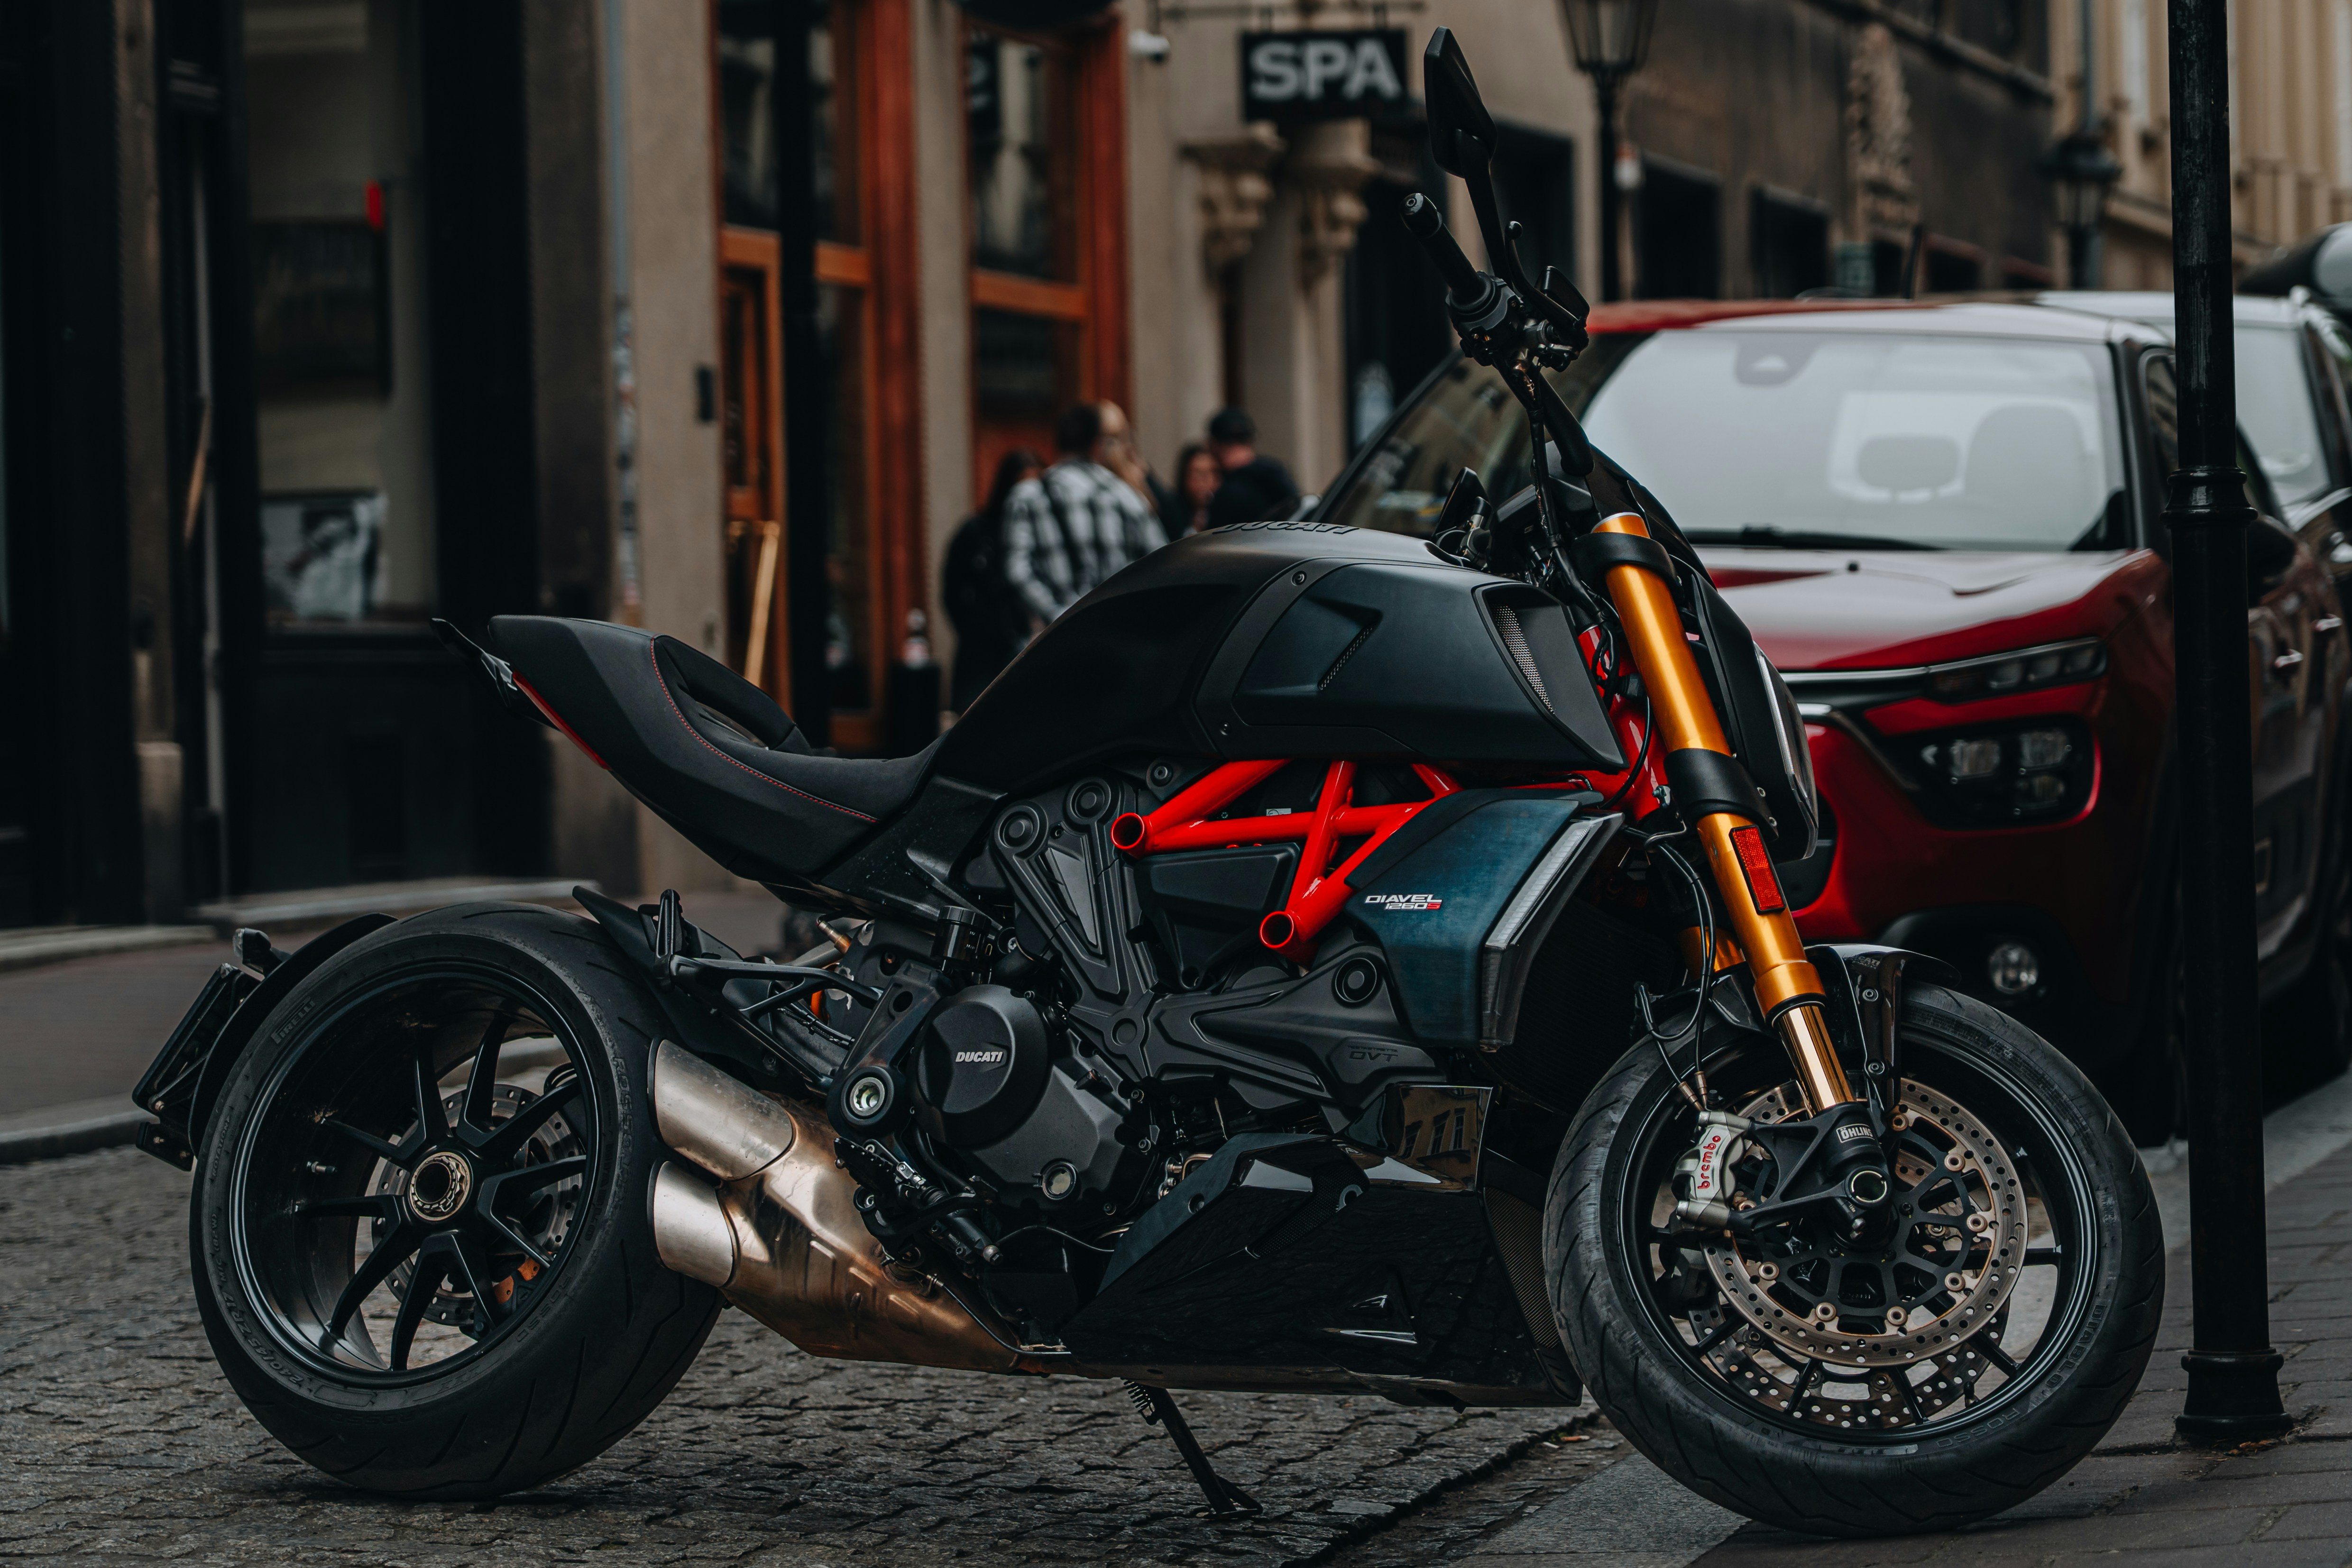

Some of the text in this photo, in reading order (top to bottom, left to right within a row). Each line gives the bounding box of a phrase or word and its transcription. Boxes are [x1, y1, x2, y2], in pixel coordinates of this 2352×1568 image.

[1250, 37, 1401, 101] SPA
[1212, 522, 1360, 534] DUCATI
[1365, 894, 1442, 903] DIAVEL
[271, 996, 315, 1044] PIRELLI
[956, 1052, 1003, 1062] DUCATI
[1349, 1051, 1398, 1062] DVT
[613, 1056, 634, 1152] ROSSO
[1840, 1127, 1873, 1139] ÖHLINS
[1935, 1304, 2107, 1449] DIABLO ROSSO
